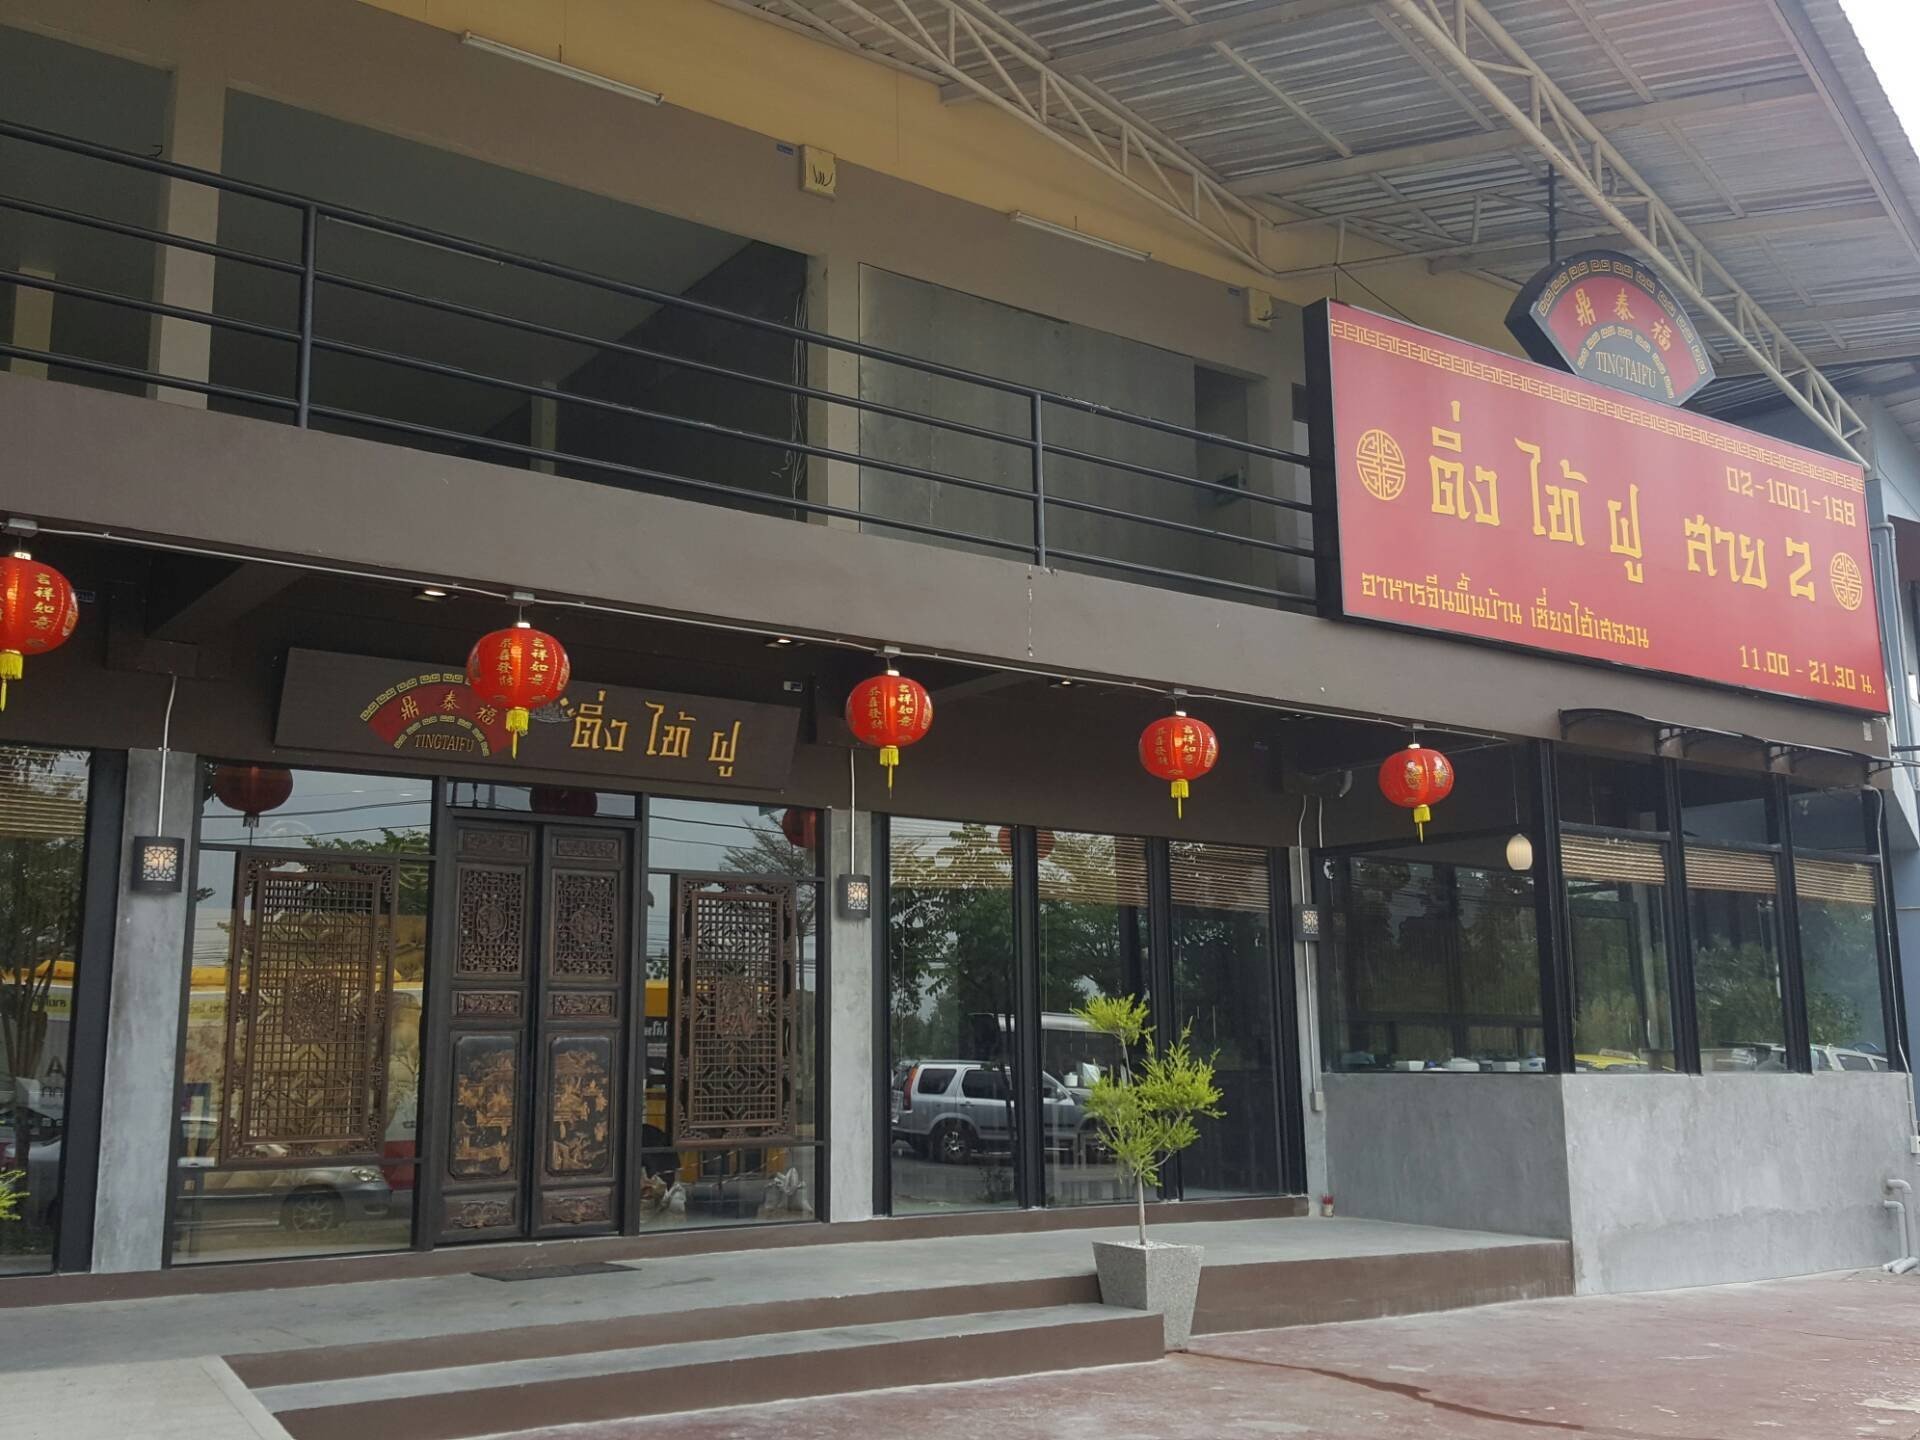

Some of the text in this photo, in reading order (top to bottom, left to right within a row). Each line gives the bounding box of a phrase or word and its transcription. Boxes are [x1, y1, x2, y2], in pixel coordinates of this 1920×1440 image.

[1595, 351, 1657, 388] TINGTAIFU
[1428, 400, 1500, 527] ติ่ง
[1684, 514, 1768, 590] สาย
[1785, 536, 1816, 602] 2
[1726, 465, 1857, 528] 02-1001-168
[1739, 645, 1790, 677] 11.00
[1808, 659, 1857, 691] 21.30
[414, 733, 476, 753] TINGTAIFU
[570, 690, 628, 752] ติ่ง
